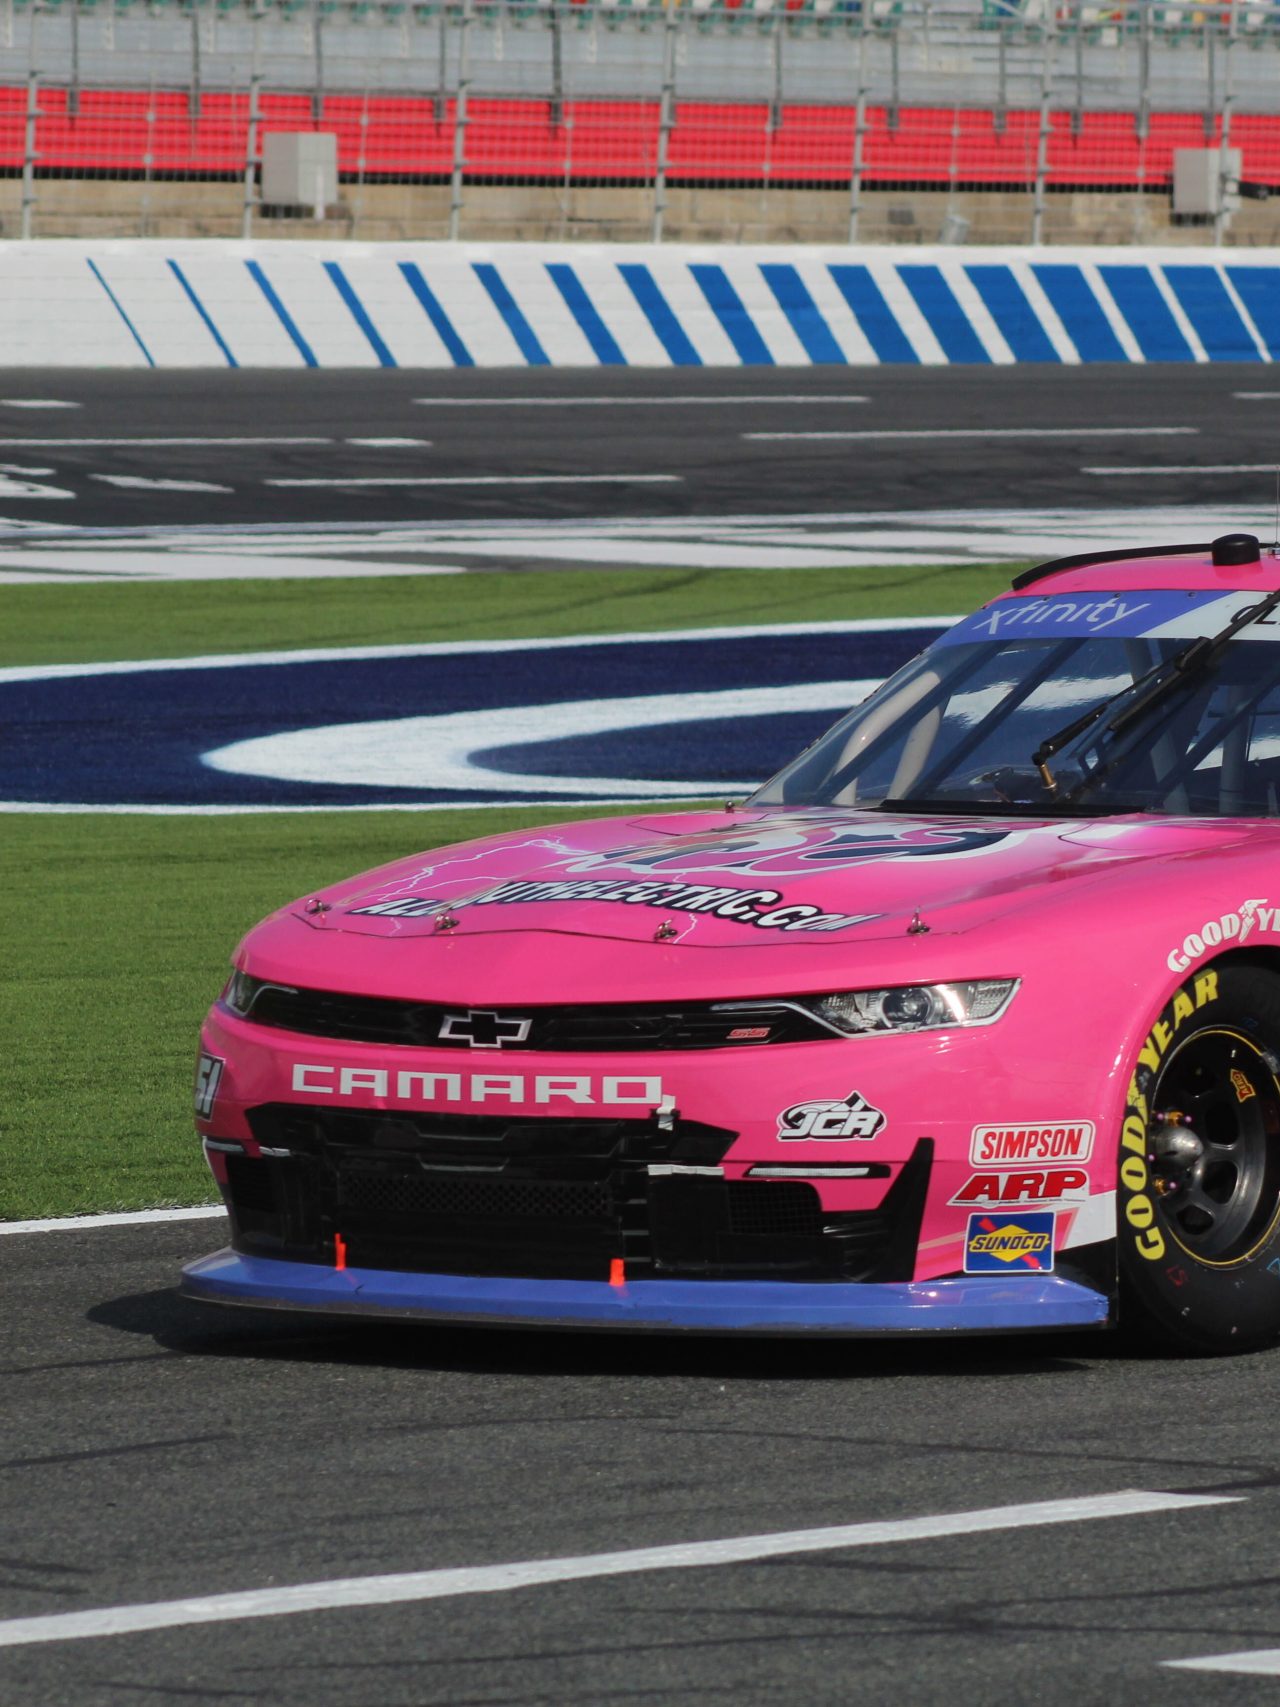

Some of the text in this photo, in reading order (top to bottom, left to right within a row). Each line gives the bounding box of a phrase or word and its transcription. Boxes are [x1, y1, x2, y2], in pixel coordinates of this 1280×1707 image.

[973, 597, 1150, 636] xfinity
[292, 1063, 661, 1104] CAMARO
[980, 1128, 1083, 1160] SIMPSON
[954, 1170, 1087, 1200] ARP
[972, 1235, 1046, 1250] SUNOCO
